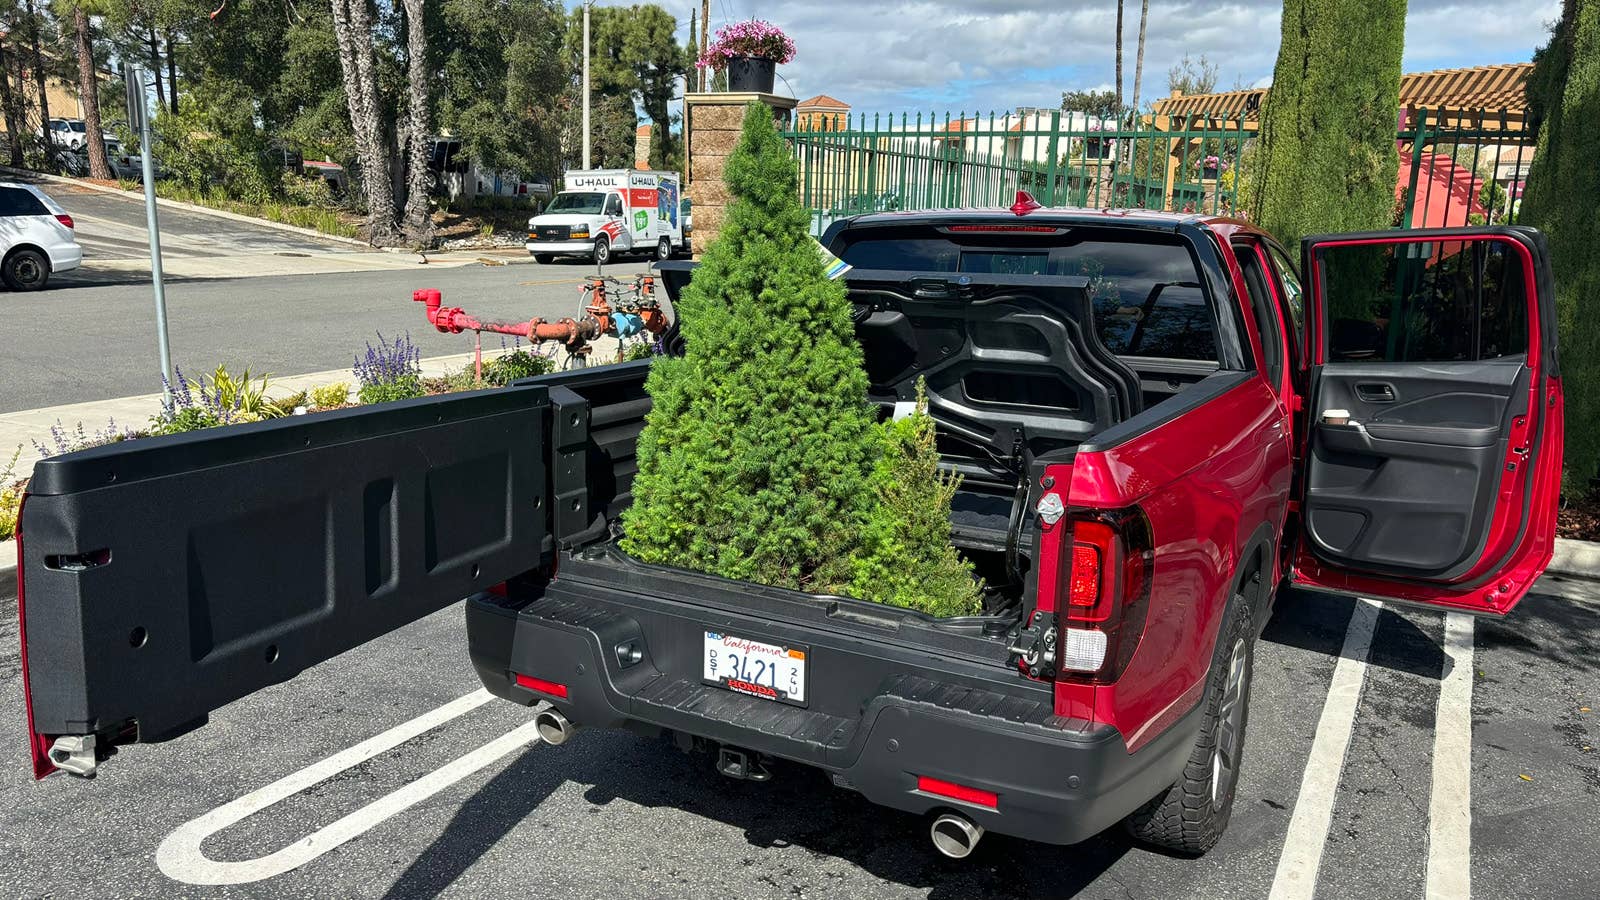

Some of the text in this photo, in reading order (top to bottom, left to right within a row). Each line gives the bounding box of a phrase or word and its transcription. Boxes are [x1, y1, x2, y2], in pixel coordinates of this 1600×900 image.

[575, 178, 617, 187] U-HAUL
[632, 177, 655, 186] U-HAUL
[723, 636, 784, 656] California
[728, 654, 775, 688] 3421
[728, 679, 777, 697] HONDA
